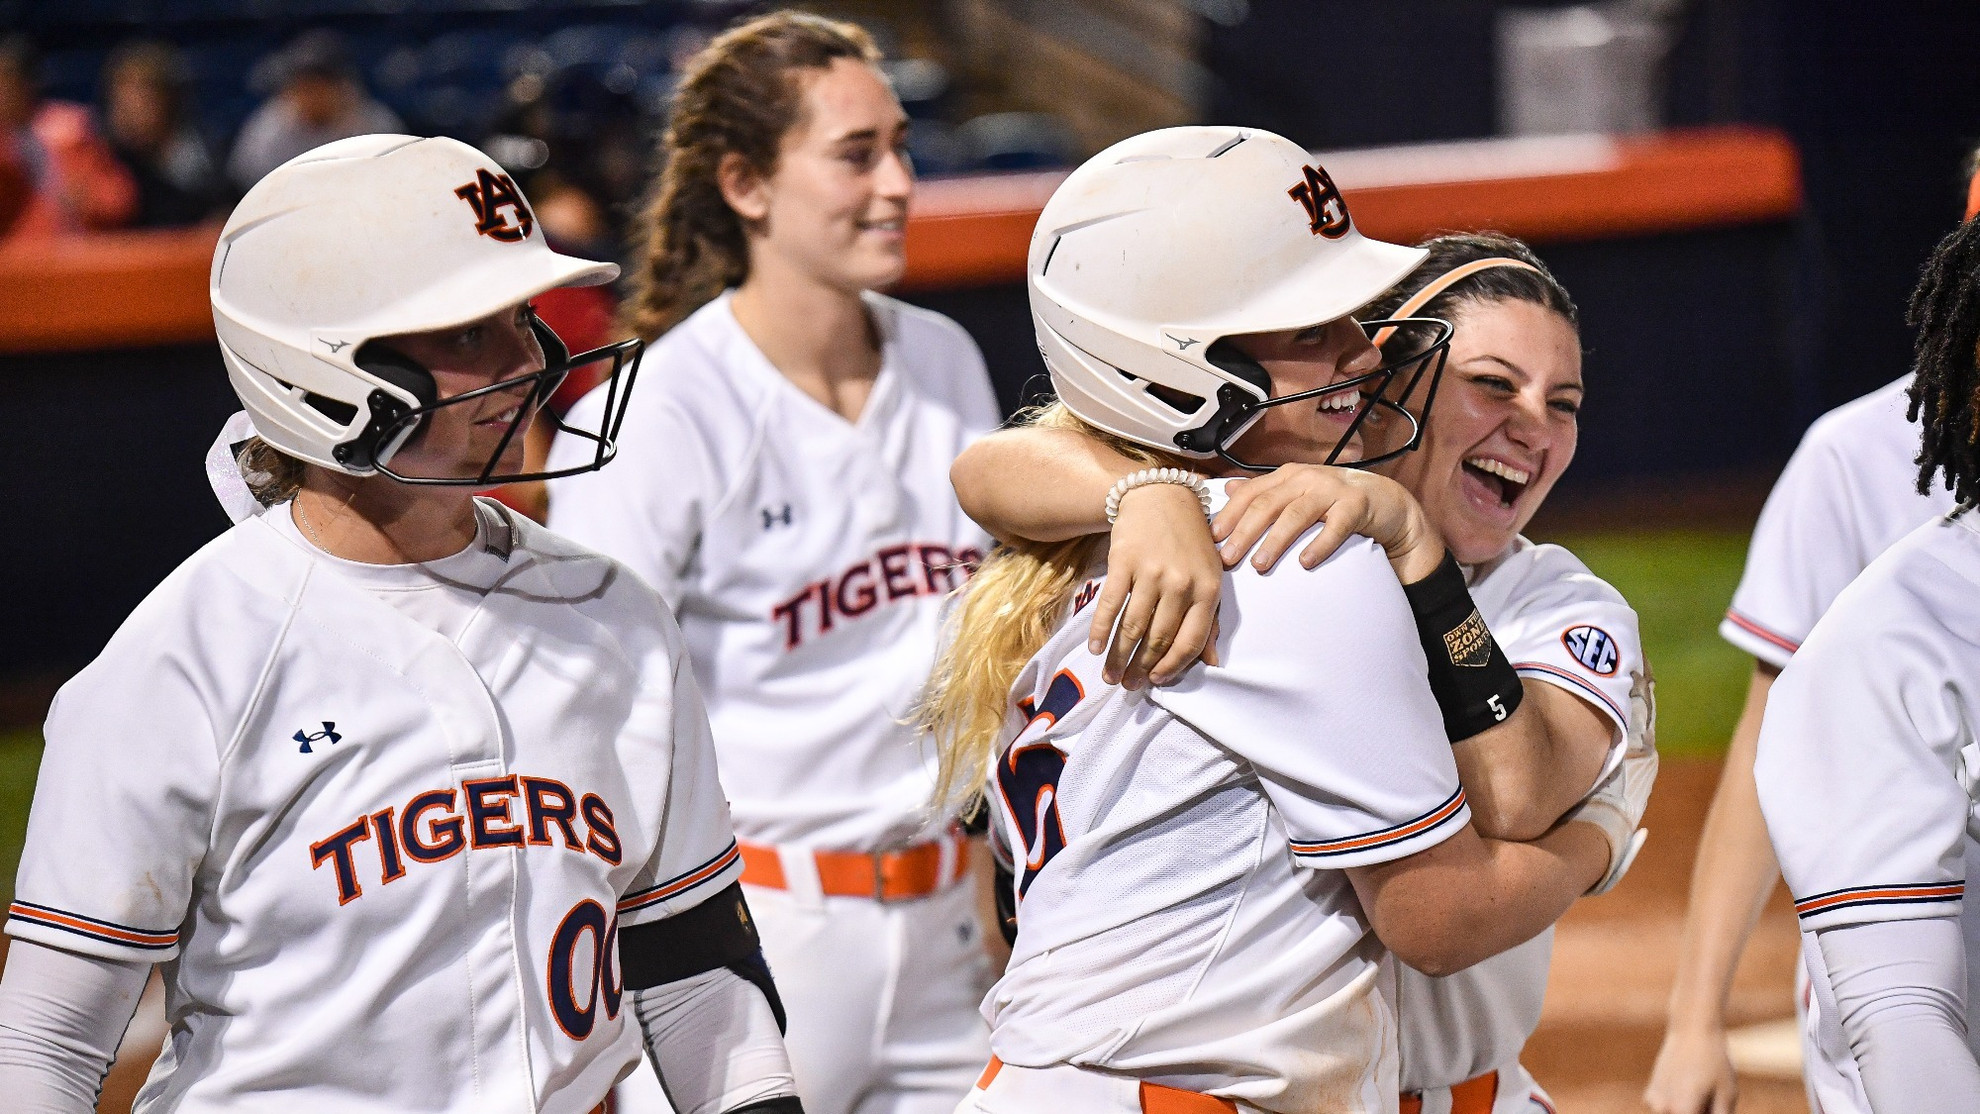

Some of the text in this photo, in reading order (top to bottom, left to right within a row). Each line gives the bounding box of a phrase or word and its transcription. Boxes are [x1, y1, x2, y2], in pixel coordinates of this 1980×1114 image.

[1447, 624, 1468, 642] OWN
[1450, 617, 1486, 654] ZONE
[1566, 626, 1618, 674] SEC
[1487, 694, 1507, 721] 5
[309, 774, 623, 906] TIGERS
